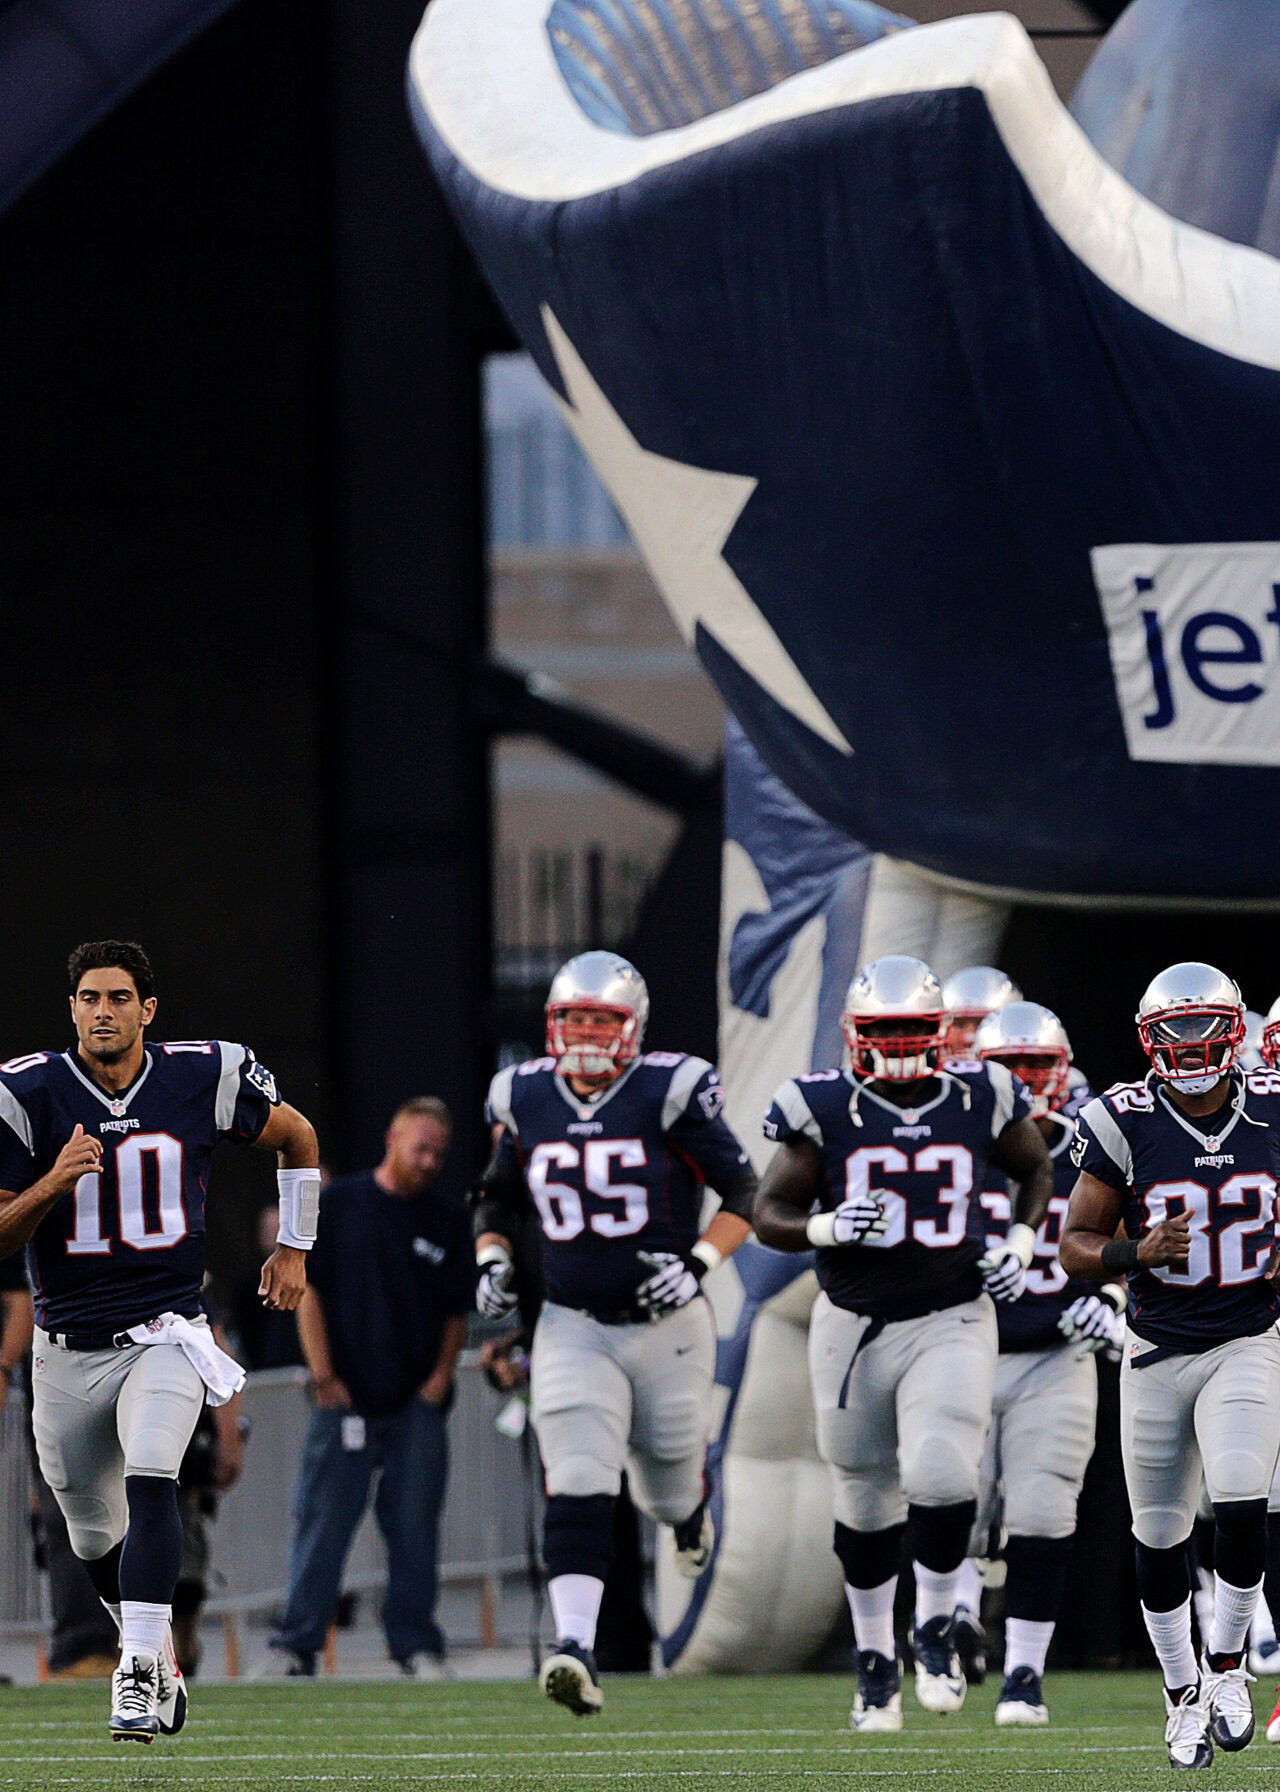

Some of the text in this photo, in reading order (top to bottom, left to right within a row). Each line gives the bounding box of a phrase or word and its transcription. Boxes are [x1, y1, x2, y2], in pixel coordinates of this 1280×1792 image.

[99, 1118, 140, 1133] PATRIOTS
[1194, 1155, 1235, 1168] PATRIOTS
[66, 1131, 189, 1255] 10
[528, 1138, 648, 1241] 65
[845, 1144, 974, 1249] 63
[1144, 1171, 1280, 1289] 82
